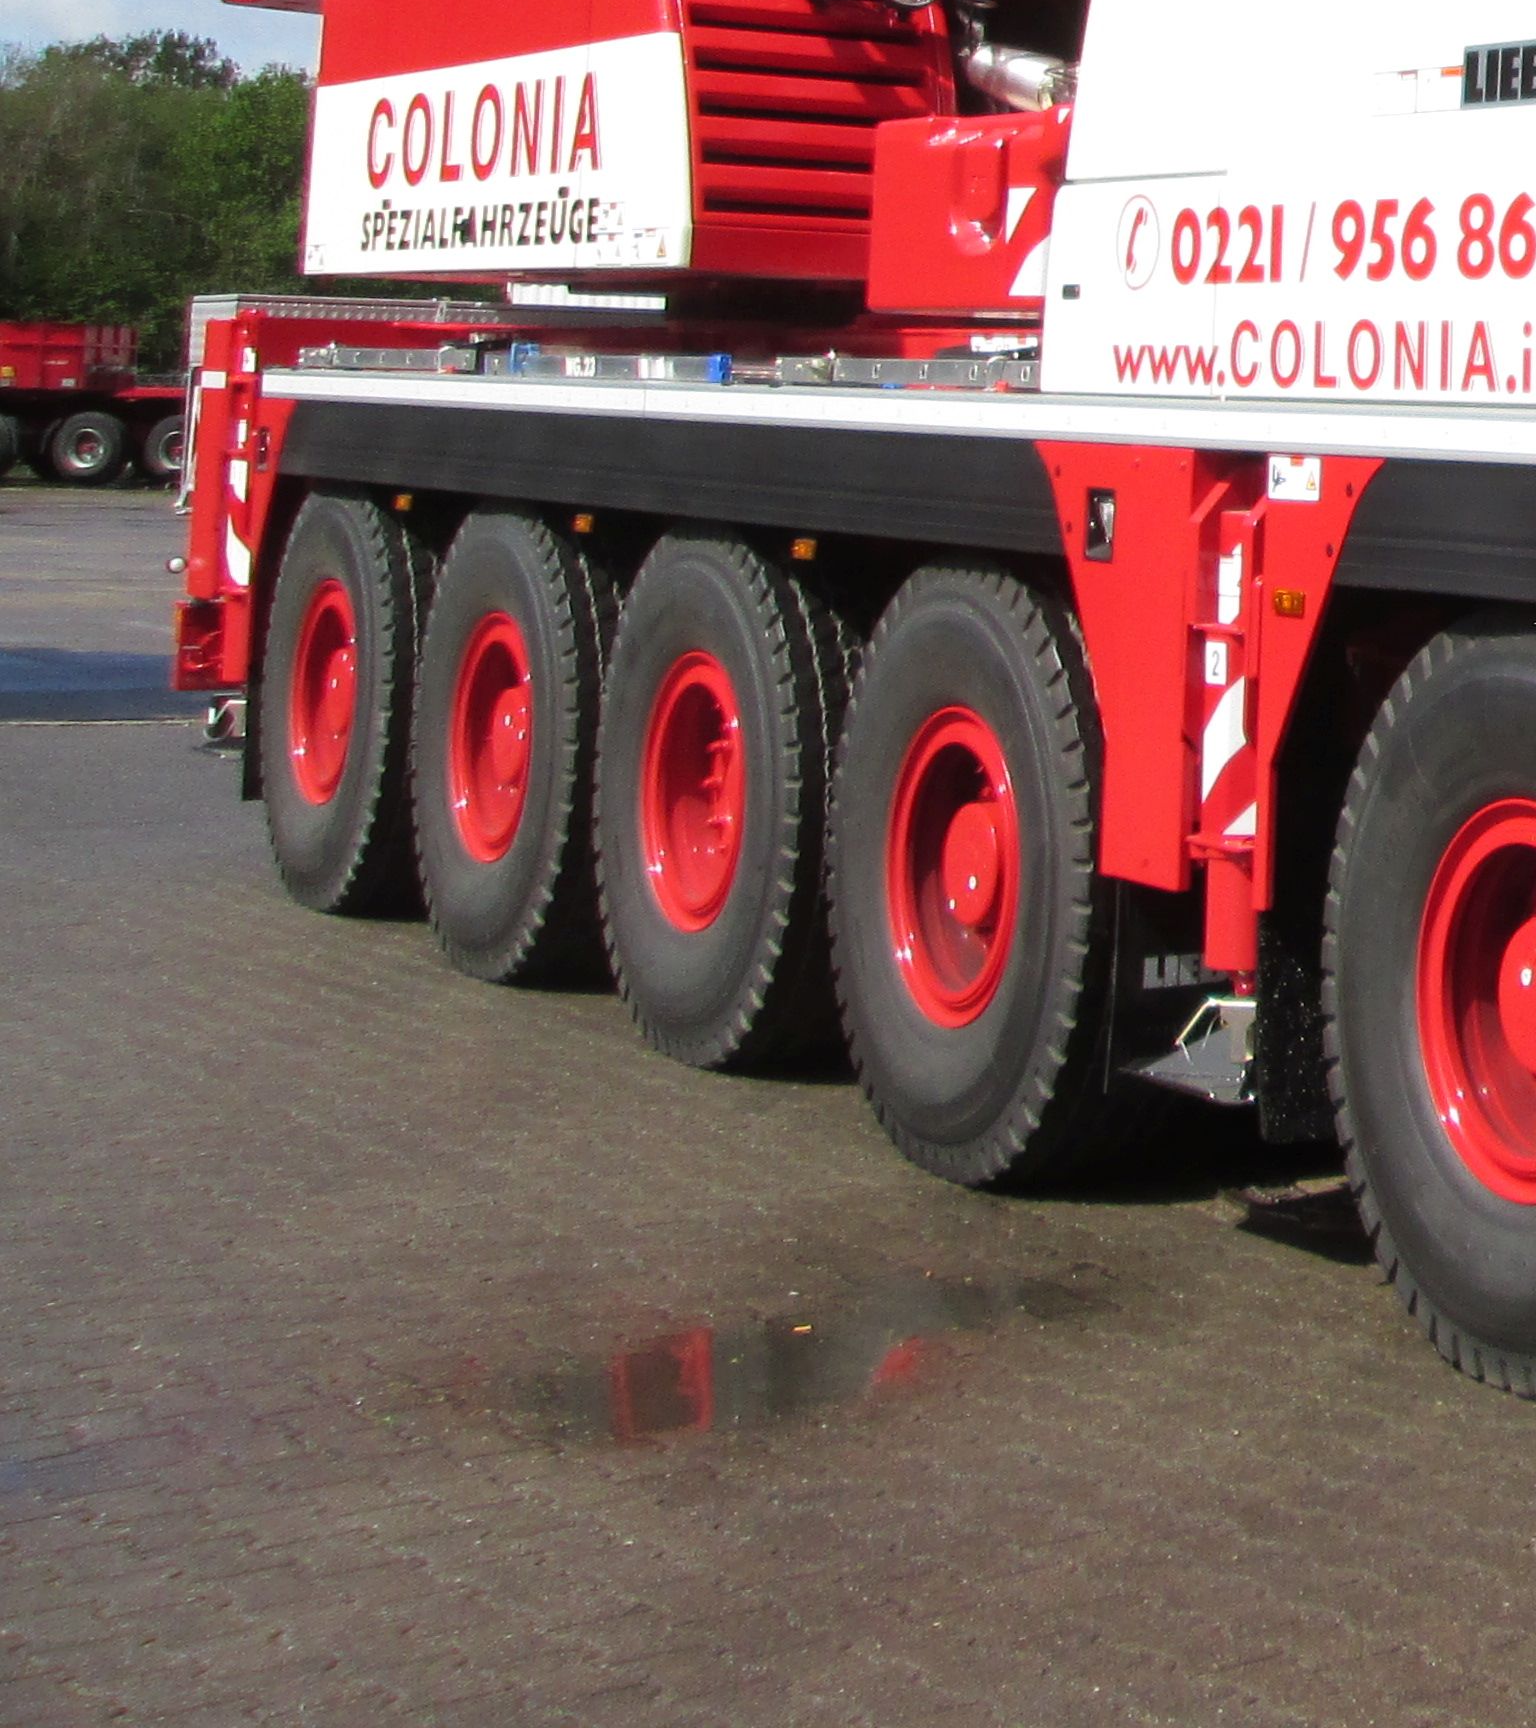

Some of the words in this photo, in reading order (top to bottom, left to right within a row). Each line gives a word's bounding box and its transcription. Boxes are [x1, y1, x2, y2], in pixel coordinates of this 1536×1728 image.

[366, 70, 600, 189] COLONIA
[360, 197, 600, 252] SPEZIALFAHRZEUGE
[1171, 204, 1284, 285] 0221
[1331, 196, 1438, 282] 956
[1211, 649, 1220, 677] 2
